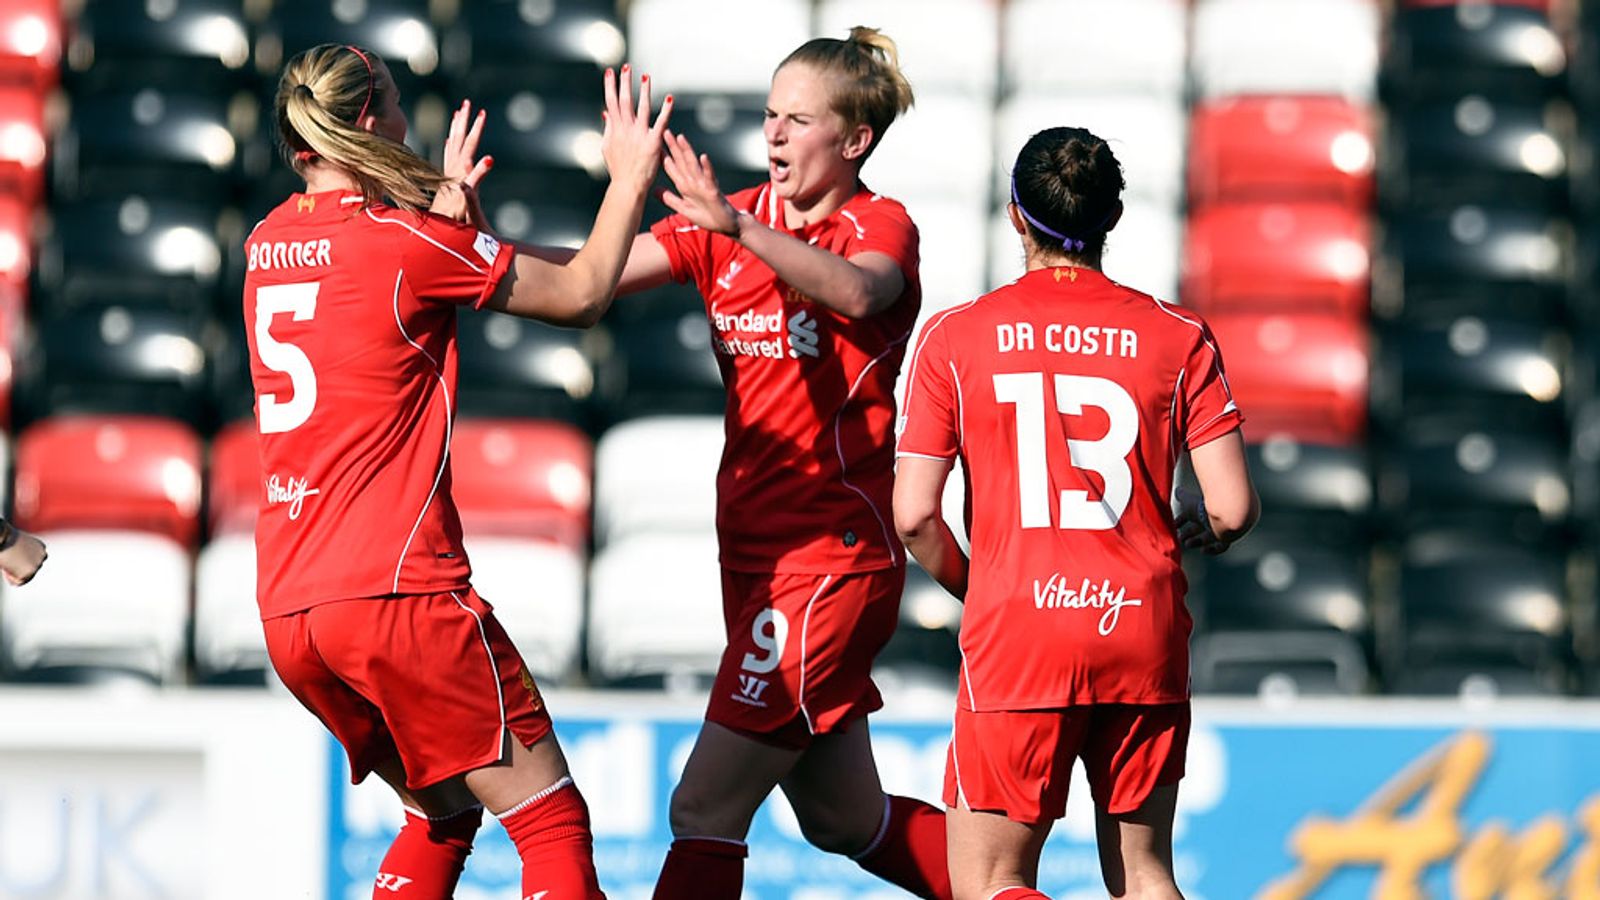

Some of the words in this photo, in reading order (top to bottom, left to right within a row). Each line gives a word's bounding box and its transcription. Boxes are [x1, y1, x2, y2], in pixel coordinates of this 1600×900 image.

[248, 238, 331, 272] BONNER
[711, 301, 783, 333] andard
[996, 322, 1034, 353] DA
[1045, 323, 1138, 358] COSTA
[254, 281, 320, 434] 5
[992, 371, 1139, 530] 13
[1033, 572, 1142, 636] Vitality
[741, 607, 789, 674] 9
